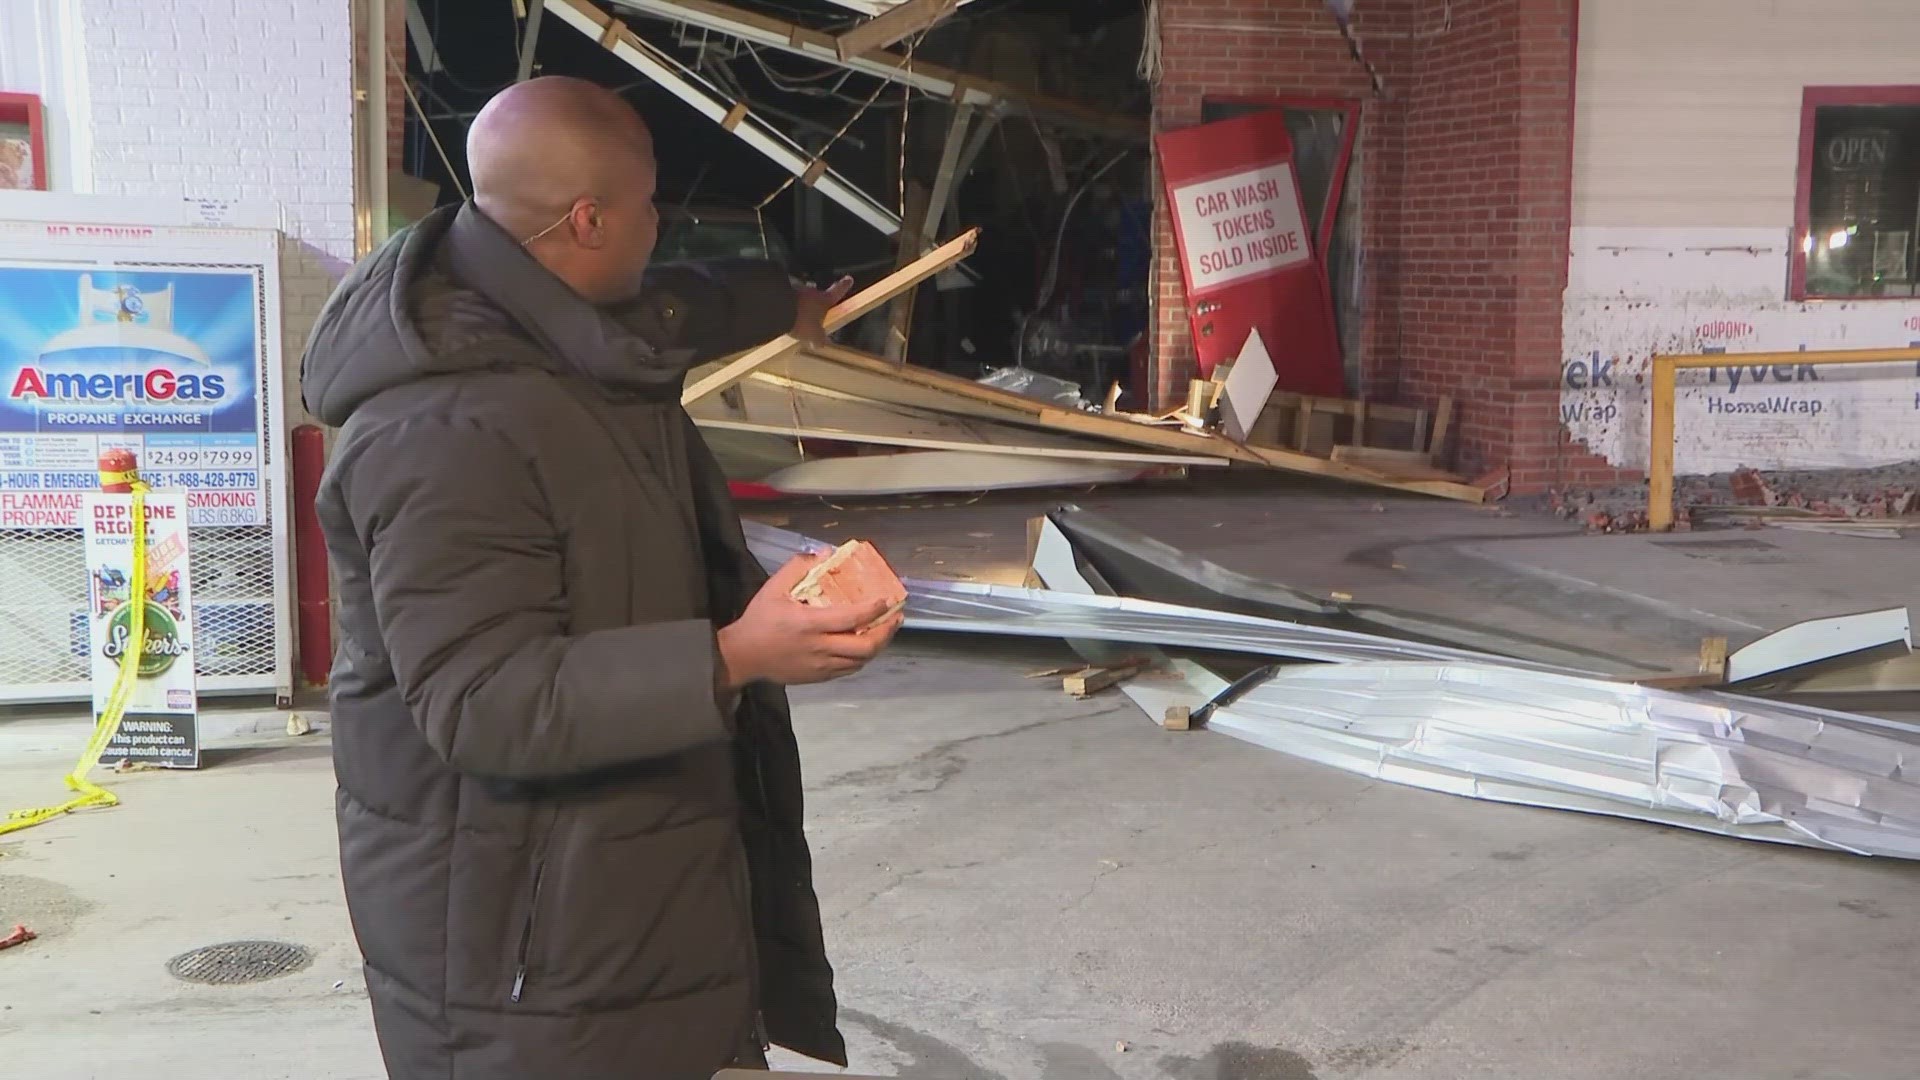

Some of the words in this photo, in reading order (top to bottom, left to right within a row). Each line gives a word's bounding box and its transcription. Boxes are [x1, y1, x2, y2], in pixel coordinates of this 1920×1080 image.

[1829, 137, 1886, 164] OPEN
[1195, 192, 1229, 217] CAR
[1231, 179, 1280, 208] WASH
[1212, 209, 1276, 242] TOKENS
[1200, 246, 1243, 275] SOLD
[1247, 231, 1299, 261] INSIDE
[1702, 321, 1747, 340] DUPONT
[11, 367, 226, 400] AmeriGas
[1708, 397, 1822, 417] HomeWrap
[48, 413, 117, 425] PROPANE
[124, 413, 202, 425] EXCHANGE
[148, 451, 199, 465] $24.99
[203, 451, 253, 465] $79.99
[0, 473, 40, 489] -HOUR
[44, 473, 102, 489] EMERGEN
[168, 472, 256, 488] 1-888-428-9779
[2, 494, 83, 510] FLAMMAB
[187, 492, 256, 508] SMOKING
[3, 511, 77, 526] PROPANE
[94, 505, 125, 519] DIP
[103, 625, 190, 658] Sker's
[122, 721, 173, 733] WARNING:
[132, 733, 167, 745] product
[168, 735, 185, 744] can
[129, 745, 159, 756] mouth
[160, 747, 193, 757] cancer.
